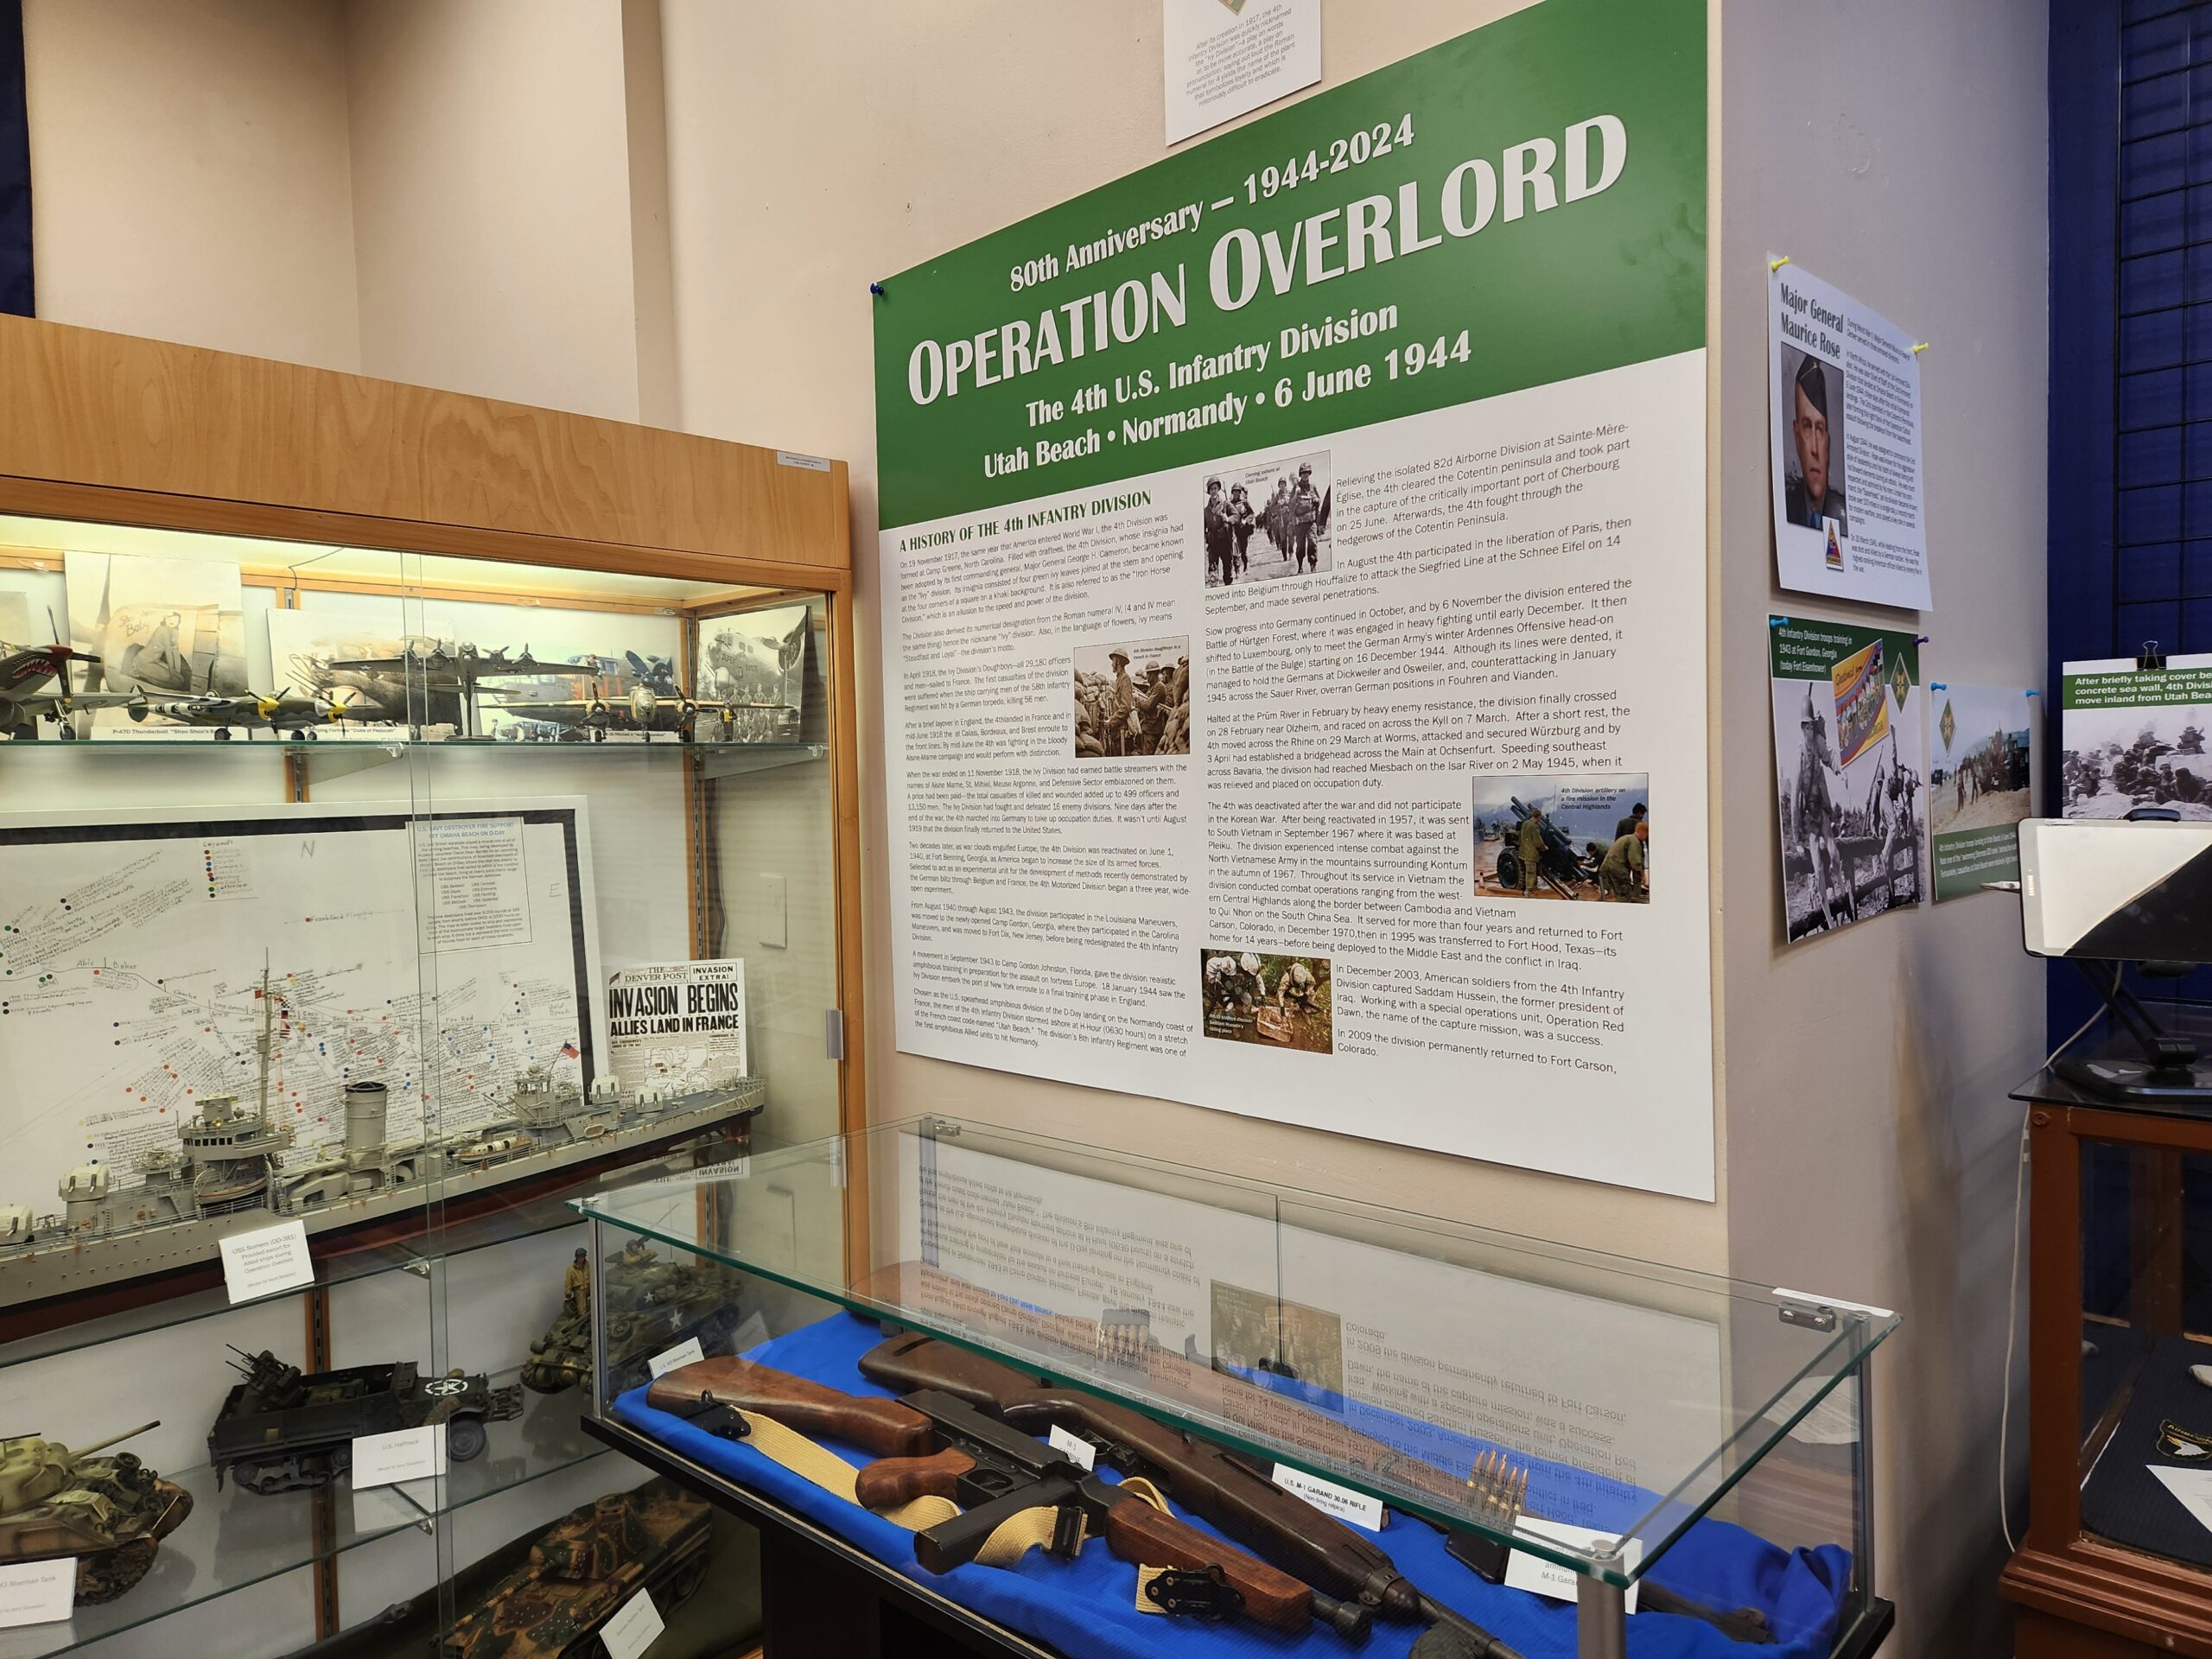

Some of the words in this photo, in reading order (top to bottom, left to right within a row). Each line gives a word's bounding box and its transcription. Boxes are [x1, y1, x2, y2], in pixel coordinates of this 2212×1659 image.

[1217, 25, 1238, 40] creation
[1262, 10, 1272, 18] the
[1010, 252, 1059, 293] 80th
[1065, 201, 1205, 271] Anniversary
[1243, 113, 1415, 207] 1944-2024
[907, 263, 1187, 407] OPERATION
[1209, 113, 1630, 312] OVERLORD
[1780, 282, 1808, 315] Major
[1810, 298, 1844, 334] General
[1780, 311, 1818, 349] Maurice
[1820, 332, 1840, 359] Rose
[1026, 400, 1066, 429] The
[1071, 382, 1108, 417] 4th
[1114, 368, 1160, 407] U.S.
[1168, 337, 1271, 390] Infantry
[1280, 301, 1399, 360] Division
[984, 443, 1030, 480] Utah
[1035, 427, 1100, 468] Beach
[1122, 391, 1249, 447] Normandy
[1274, 376, 1294, 410] 6
[1302, 361, 1372, 404] June
[1383, 328, 1472, 382] 1944
[1336, 473, 1376, 488] Relieving
[1377, 470, 1392, 480] the
[1395, 461, 1431, 477] isolated
[1433, 456, 1452, 470] 82d
[1455, 449, 1497, 466] Airborne
[1500, 441, 1541, 456] Division
[1543, 436, 1555, 448] at
[1557, 423, 1629, 445] Sainte-Mère-
[899, 539, 907, 553] A
[910, 530, 957, 552] HISTORY
[959, 526, 974, 542] OF
[978, 522, 1001, 538] THE
[1003, 515, 1024, 533] 4th
[1027, 502, 1089, 529] INFANTRY
[1091, 489, 1153, 517] DIVISION
[1803, 630, 1821, 640] Division
[1821, 632, 1834, 643] troops
[1796, 645, 1805, 656] Fort
[1822, 649, 1837, 660] Georgia
[1793, 662, 1802, 671] Fort
[1802, 662, 1826, 674] Eisenhower)
[2101, 676, 2133, 684] briefly
[2135, 674, 2167, 683] taking
[2075, 686, 2117, 695] concrete
[2105, 695, 2134, 703] inland
[2164, 692, 2188, 701] Utah
[301, 840, 315, 859] N
[625, 973, 662, 982] DENVER
[692, 966, 734, 975] INVASION
[609, 985, 678, 1019] INVASION
[687, 982, 739, 1014] BEGINS
[610, 1020, 648, 1037] ALLIES
[651, 1017, 680, 1034] LAND
[683, 1017, 691, 1033] IN
[696, 1014, 739, 1032] FRANCE
[1338, 1028, 1345, 1038] In
[1348, 1029, 1372, 1041] 2009
[1374, 1033, 1389, 1044] the
[1391, 1035, 1426, 1048] division
[1428, 1041, 1488, 1058] permanently
[1491, 1049, 1534, 1063] returned
[1537, 1054, 1548, 1065] to
[1551, 1055, 1572, 1068] Fort
[1574, 1058, 1617, 1075] Carson,
[242, 1249, 265, 1260] Provided
[246, 1242, 270, 1251] Somers
[1067, 1440, 1077, 1451] M-1
[1284, 1478, 1294, 1486] U.S.
[1296, 1482, 1306, 1491] M-1
[1307, 1486, 1332, 1499] GARAND
[1333, 1495, 1349, 1505] 30.06
[1350, 1500, 1367, 1511] RIFLE
[1541, 1572, 1555, 1582] M-1
[1557, 1574, 1577, 1586] Gara
